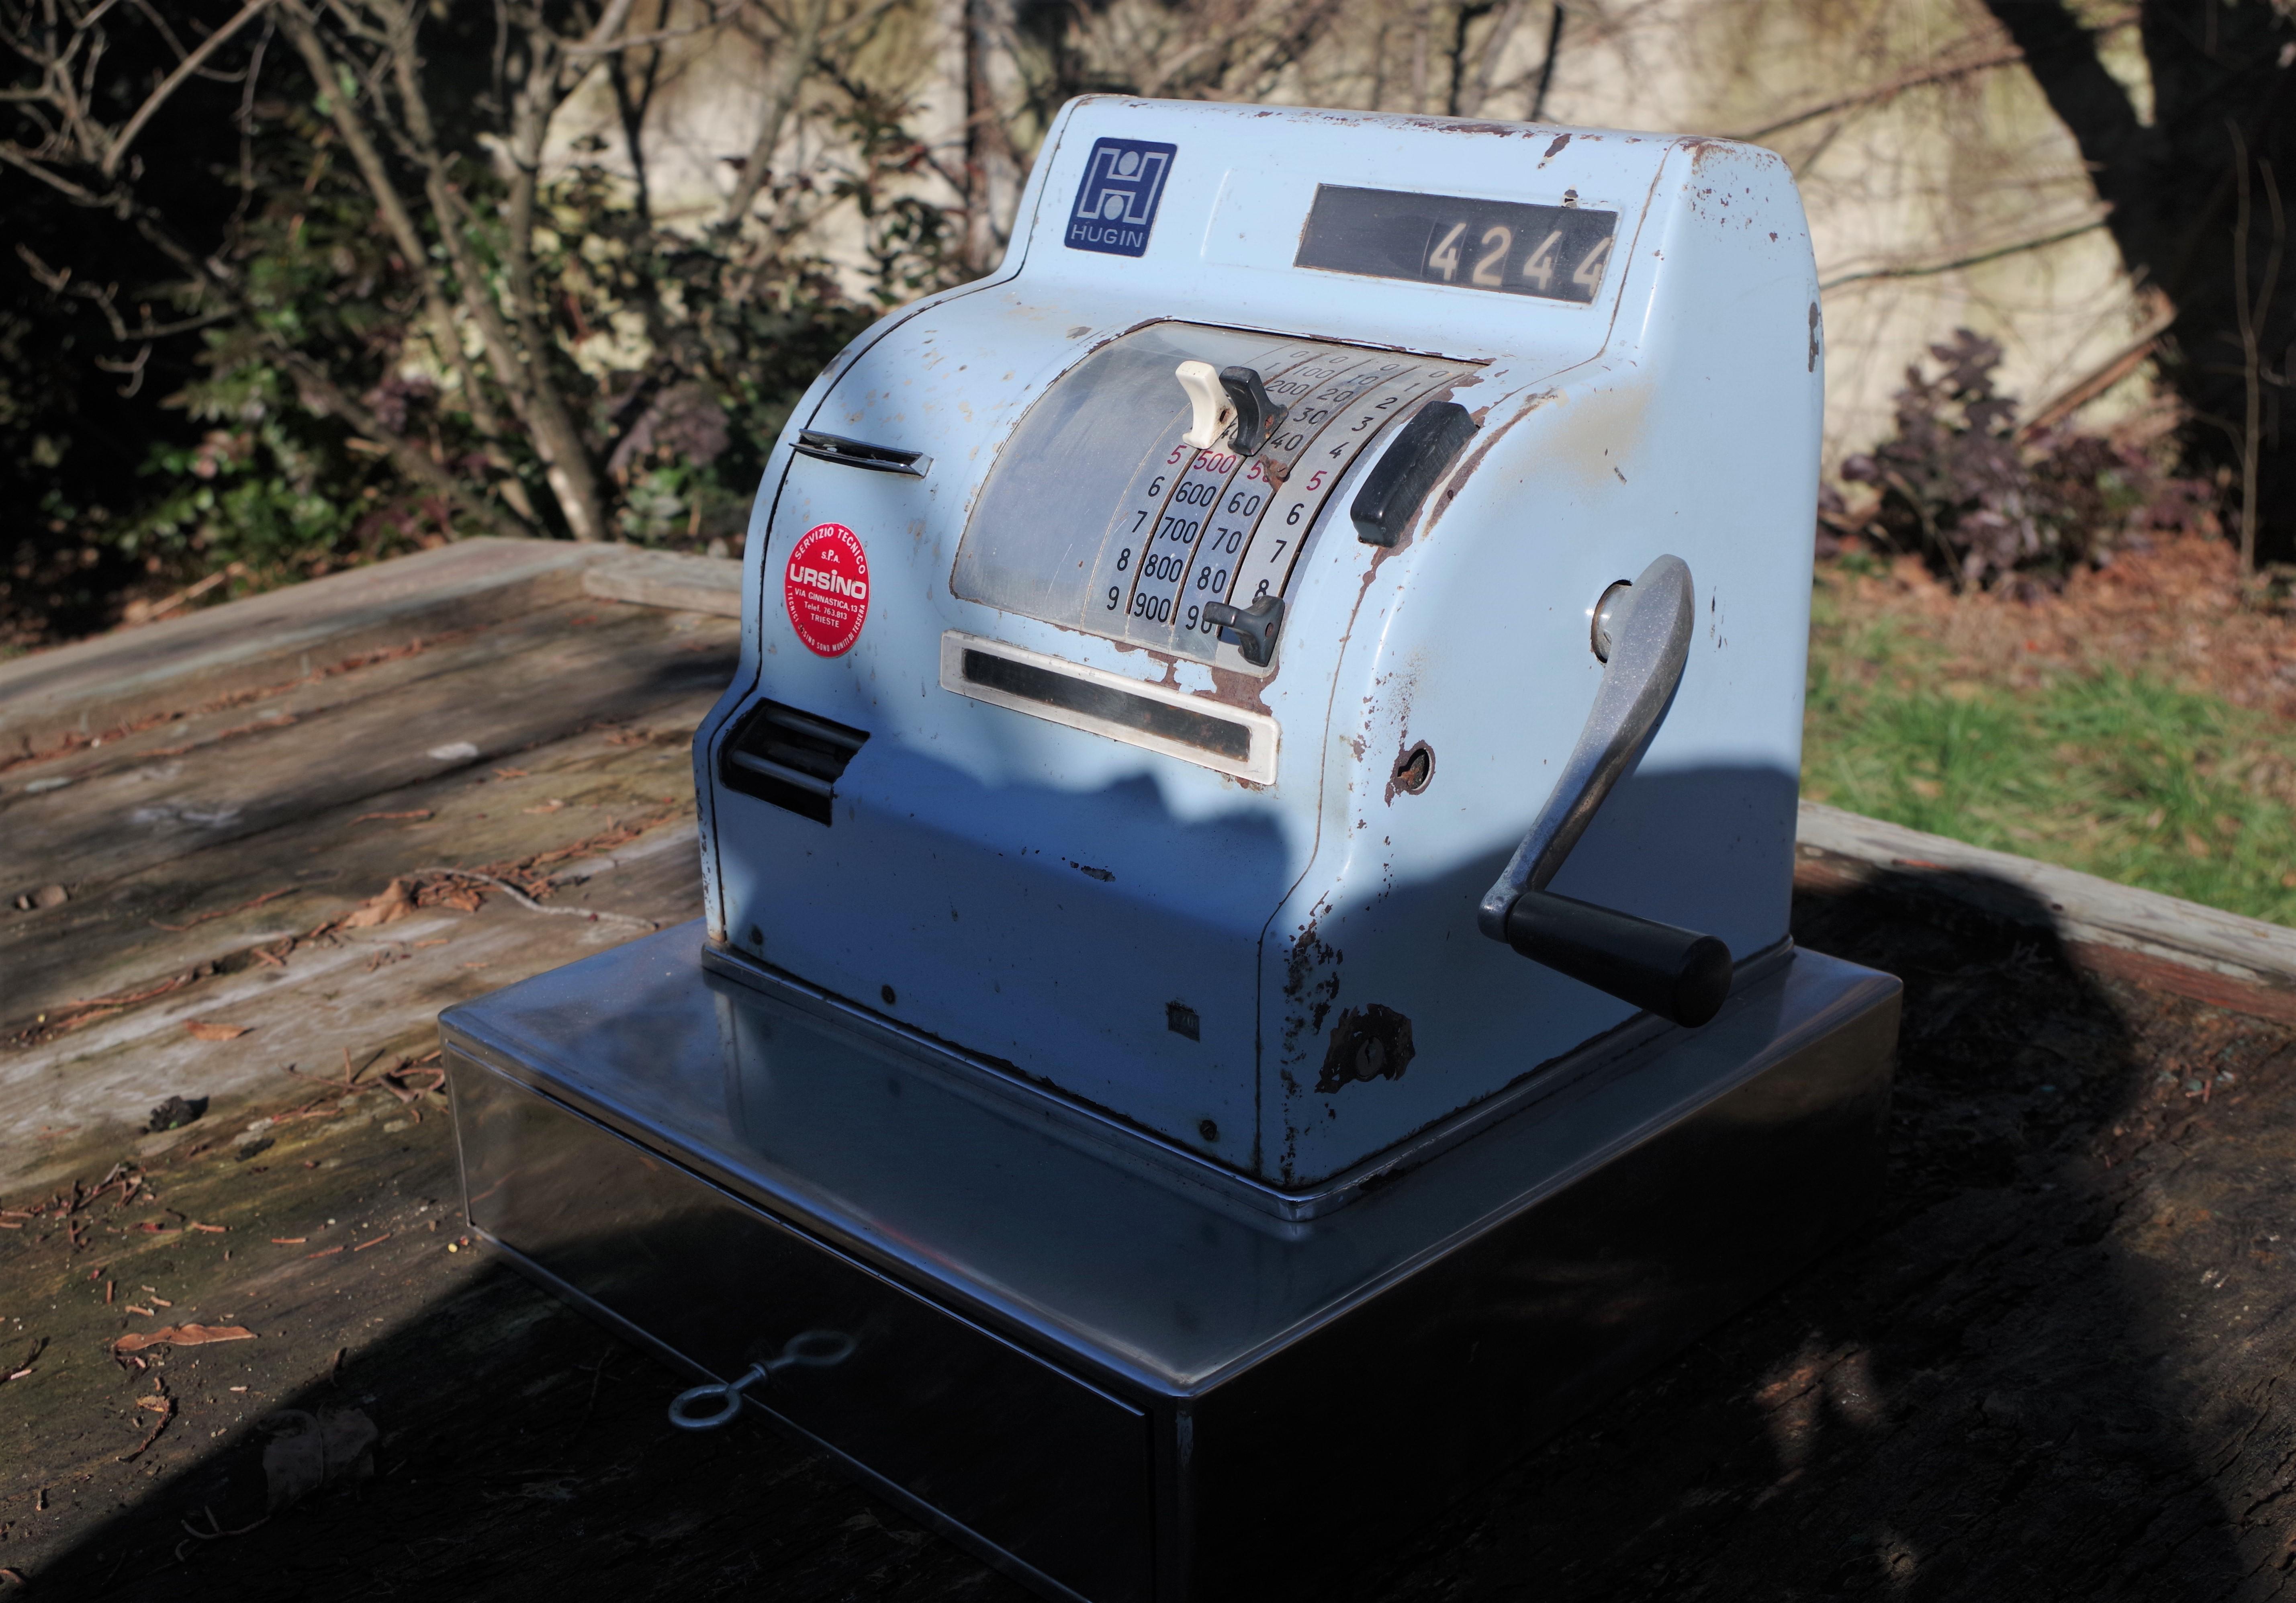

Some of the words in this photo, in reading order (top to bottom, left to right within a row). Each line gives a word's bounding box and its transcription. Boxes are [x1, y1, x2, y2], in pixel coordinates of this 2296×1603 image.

[1071, 224, 1143, 248] HUGIN
[1429, 222, 1613, 297] 4244
[1264, 362, 1281, 371] 1
[1292, 366, 1335, 379] 100
[1347, 374, 1379, 385] 10
[1403, 383, 1421, 392] 1
[1265, 380, 1310, 395] 200
[1316, 388, 1353, 402] 20
[1375, 397, 1398, 409] 2
[1293, 407, 1328, 425] 30
[1351, 416, 1374, 431] 3
[1270, 432, 1304, 451] 40
[1329, 442, 1350, 459] 4
[1167, 445, 1187, 464] 5
[1193, 450, 1237, 474] 500
[1247, 460, 1269, 483] 5
[1306, 470, 1327, 491] 5
[1148, 476, 1165, 497] 6
[1176, 481, 1216, 507] 600
[1228, 492, 1260, 516] 60
[1286, 503, 1304, 525] 6
[795, 526, 834, 560] SERVIZIO
[838, 528, 865, 574] TECNICO
[1132, 510, 1148, 533] 7
[1159, 517, 1198, 544] 700
[1211, 527, 1242, 554] 70
[1270, 539, 1287, 563] 7
[1117, 548, 1131, 571] 8
[1145, 554, 1183, 582] 800
[1197, 566, 1226, 594] 80
[1254, 579, 1269, 597] 8
[787, 592, 799, 622] TECNICI
[816, 642, 830, 651] SONO
[832, 637, 850, 651] MUNITI
[848, 632, 854, 641] DI
[852, 604, 865, 633] TESSERA
[804, 601, 821, 612] Telef.
[824, 607, 847, 620] 763.813
[811, 613, 839, 628] TRIESTE
[1107, 586, 1119, 610] 9
[1134, 593, 1171, 622] 900
